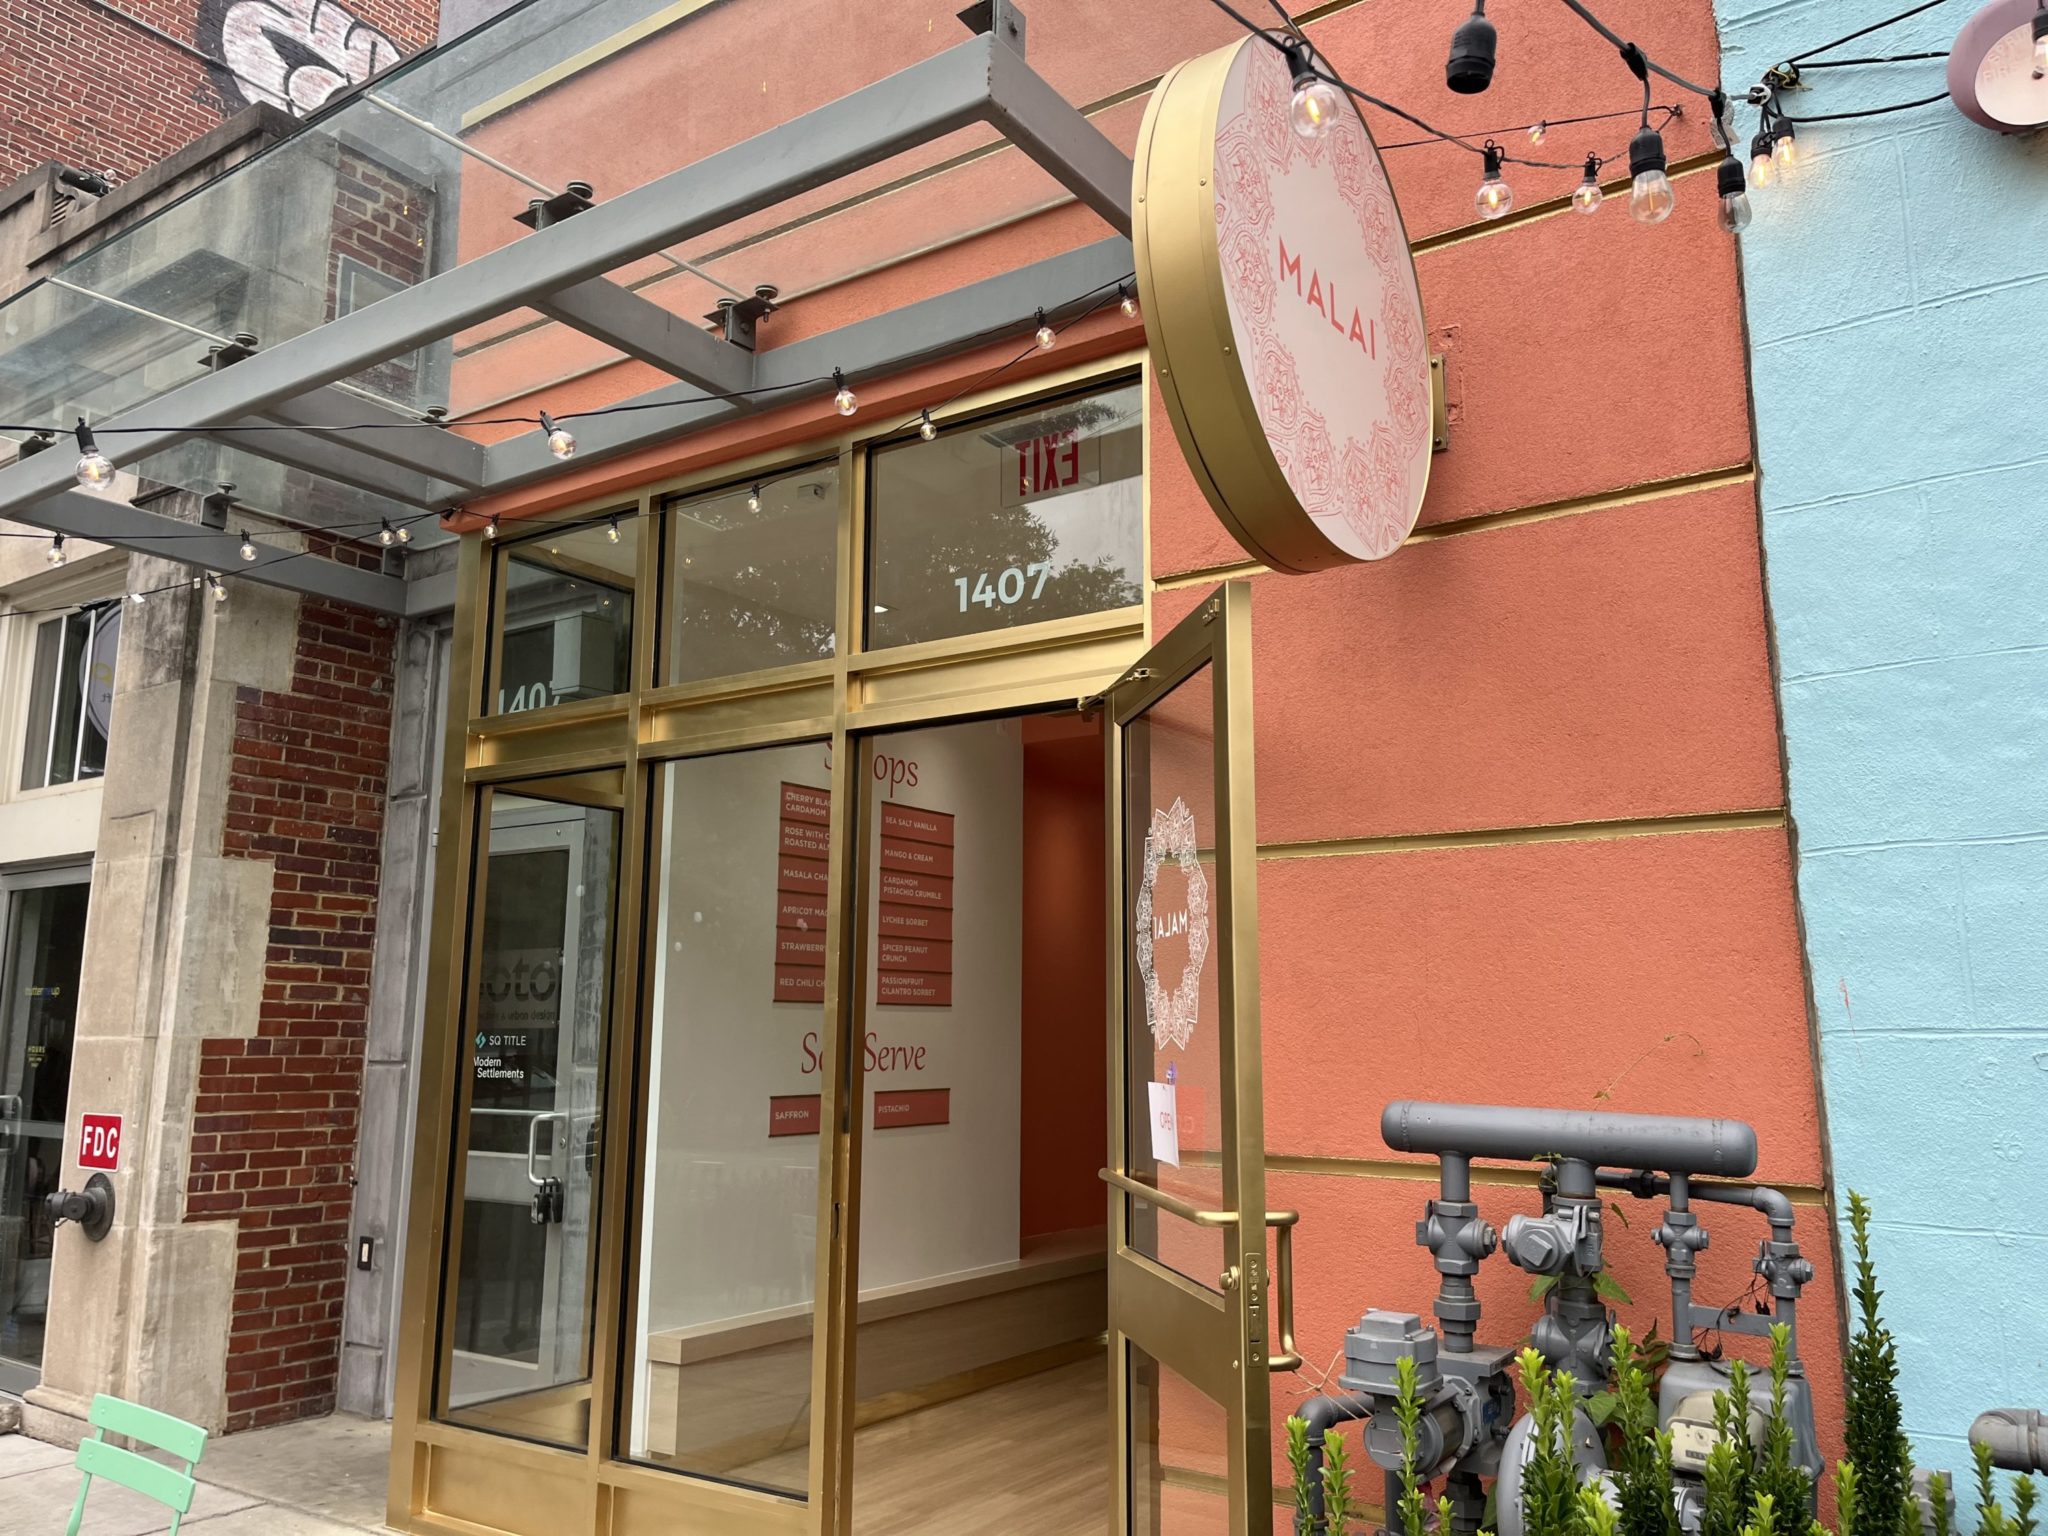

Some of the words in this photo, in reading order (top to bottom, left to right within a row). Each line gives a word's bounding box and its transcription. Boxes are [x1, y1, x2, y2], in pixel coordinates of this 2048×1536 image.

[1279, 234, 1376, 361] MALAI
[954, 560, 1051, 613] 1407
[785, 792, 814, 803] CHERRY
[785, 803, 827, 816] CARDAMOM
[885, 815, 897, 824] SEA
[898, 818, 913, 827] SALT
[913, 821, 938, 831] VANILLA
[784, 826, 804, 836] ROSE
[805, 829, 824, 839] WITH
[784, 837, 817, 849] ROASTED
[884, 848, 907, 859] MANGO
[913, 853, 934, 862] CREAM
[783, 869, 813, 879] MASALA
[883, 875, 918, 886] CARDAMOM
[883, 886, 914, 897] PISTACHIO
[915, 889, 942, 899] CRUMBLE
[782, 905, 813, 915] APRICOT
[882, 915, 904, 925] LYCHEE
[905, 917, 928, 927] SORBET
[882, 943, 904, 952] SPICED
[905, 945, 928, 953] PEANUT
[882, 954, 907, 963] CRUNCH
[780, 977, 794, 986] RED
[796, 978, 815, 988] CHILI
[881, 976, 924, 985] PASSIONFRUIT
[881, 987, 912, 996] CILANTRO
[913, 988, 936, 997] SORBET
[489, 1035, 501, 1046] SQ
[503, 1035, 527, 1046] TITLE
[477, 1067, 525, 1079] Settlements
[878, 1104, 910, 1113] PISTACHIO
[775, 1110, 809, 1120] SAFFRON
[82, 1125, 118, 1158] FDC
